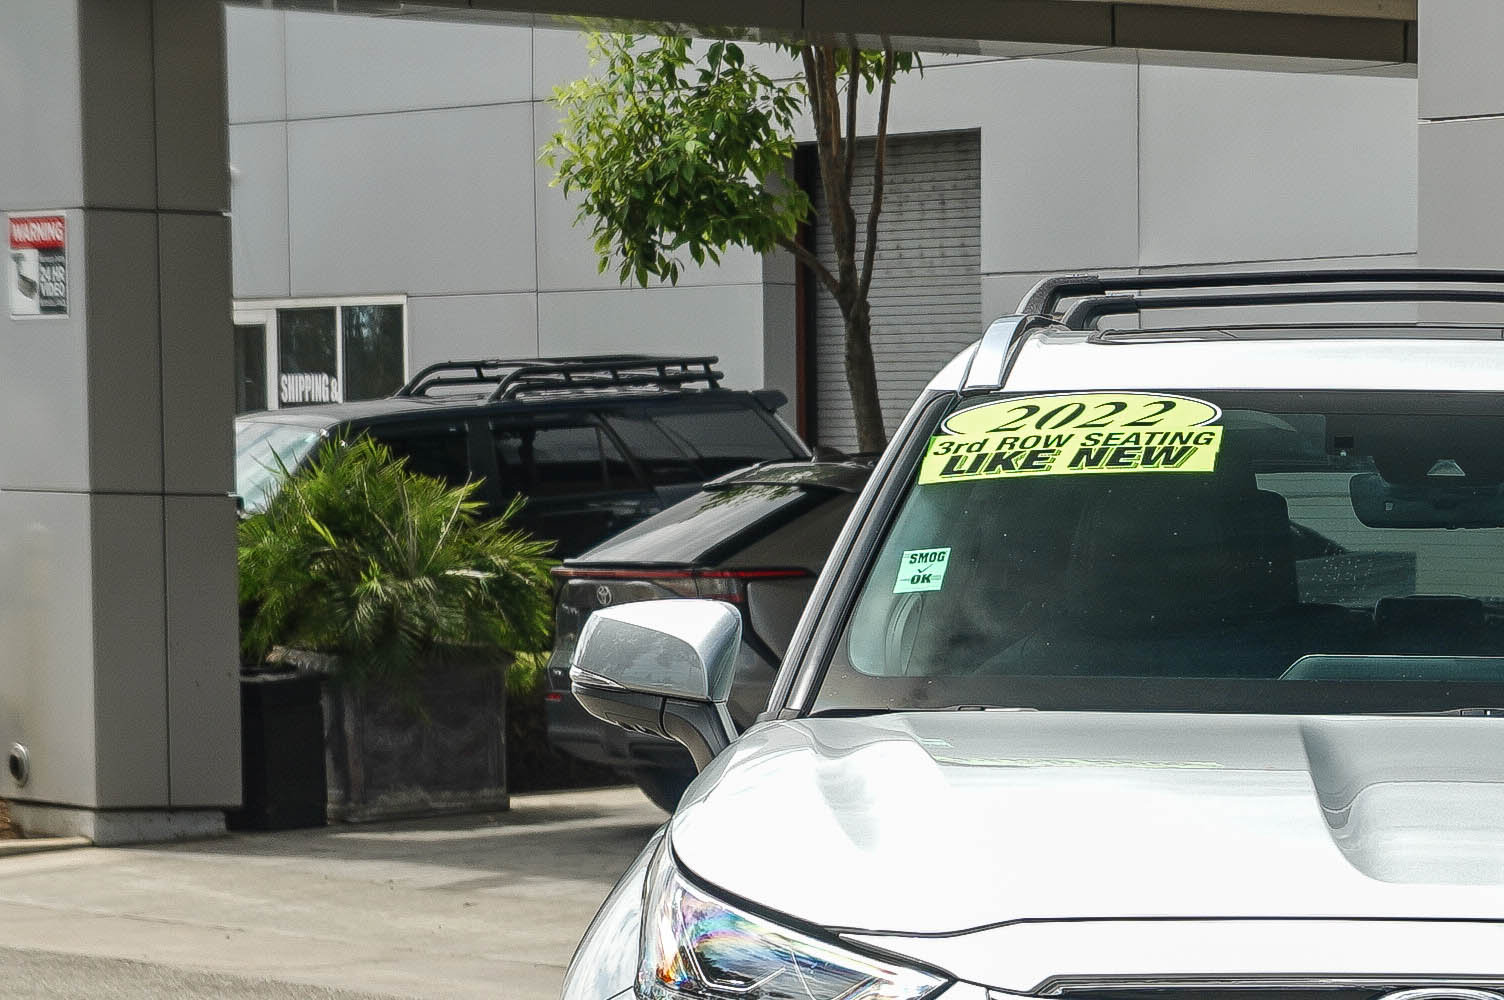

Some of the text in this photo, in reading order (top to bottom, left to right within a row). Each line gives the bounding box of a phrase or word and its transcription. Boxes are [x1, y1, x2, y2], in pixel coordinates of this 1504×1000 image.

[12, 221, 64, 242] WARNING
[41, 281, 66, 297] VIDEO
[280, 373, 329, 403] SHIPPING
[985, 400, 1177, 433] 2022
[933, 432, 1216, 456] 3rd ROW SEATING
[939, 446, 1198, 478] LIKE NEW
[909, 551, 946, 564] SMOG
[911, 574, 932, 584] OK
